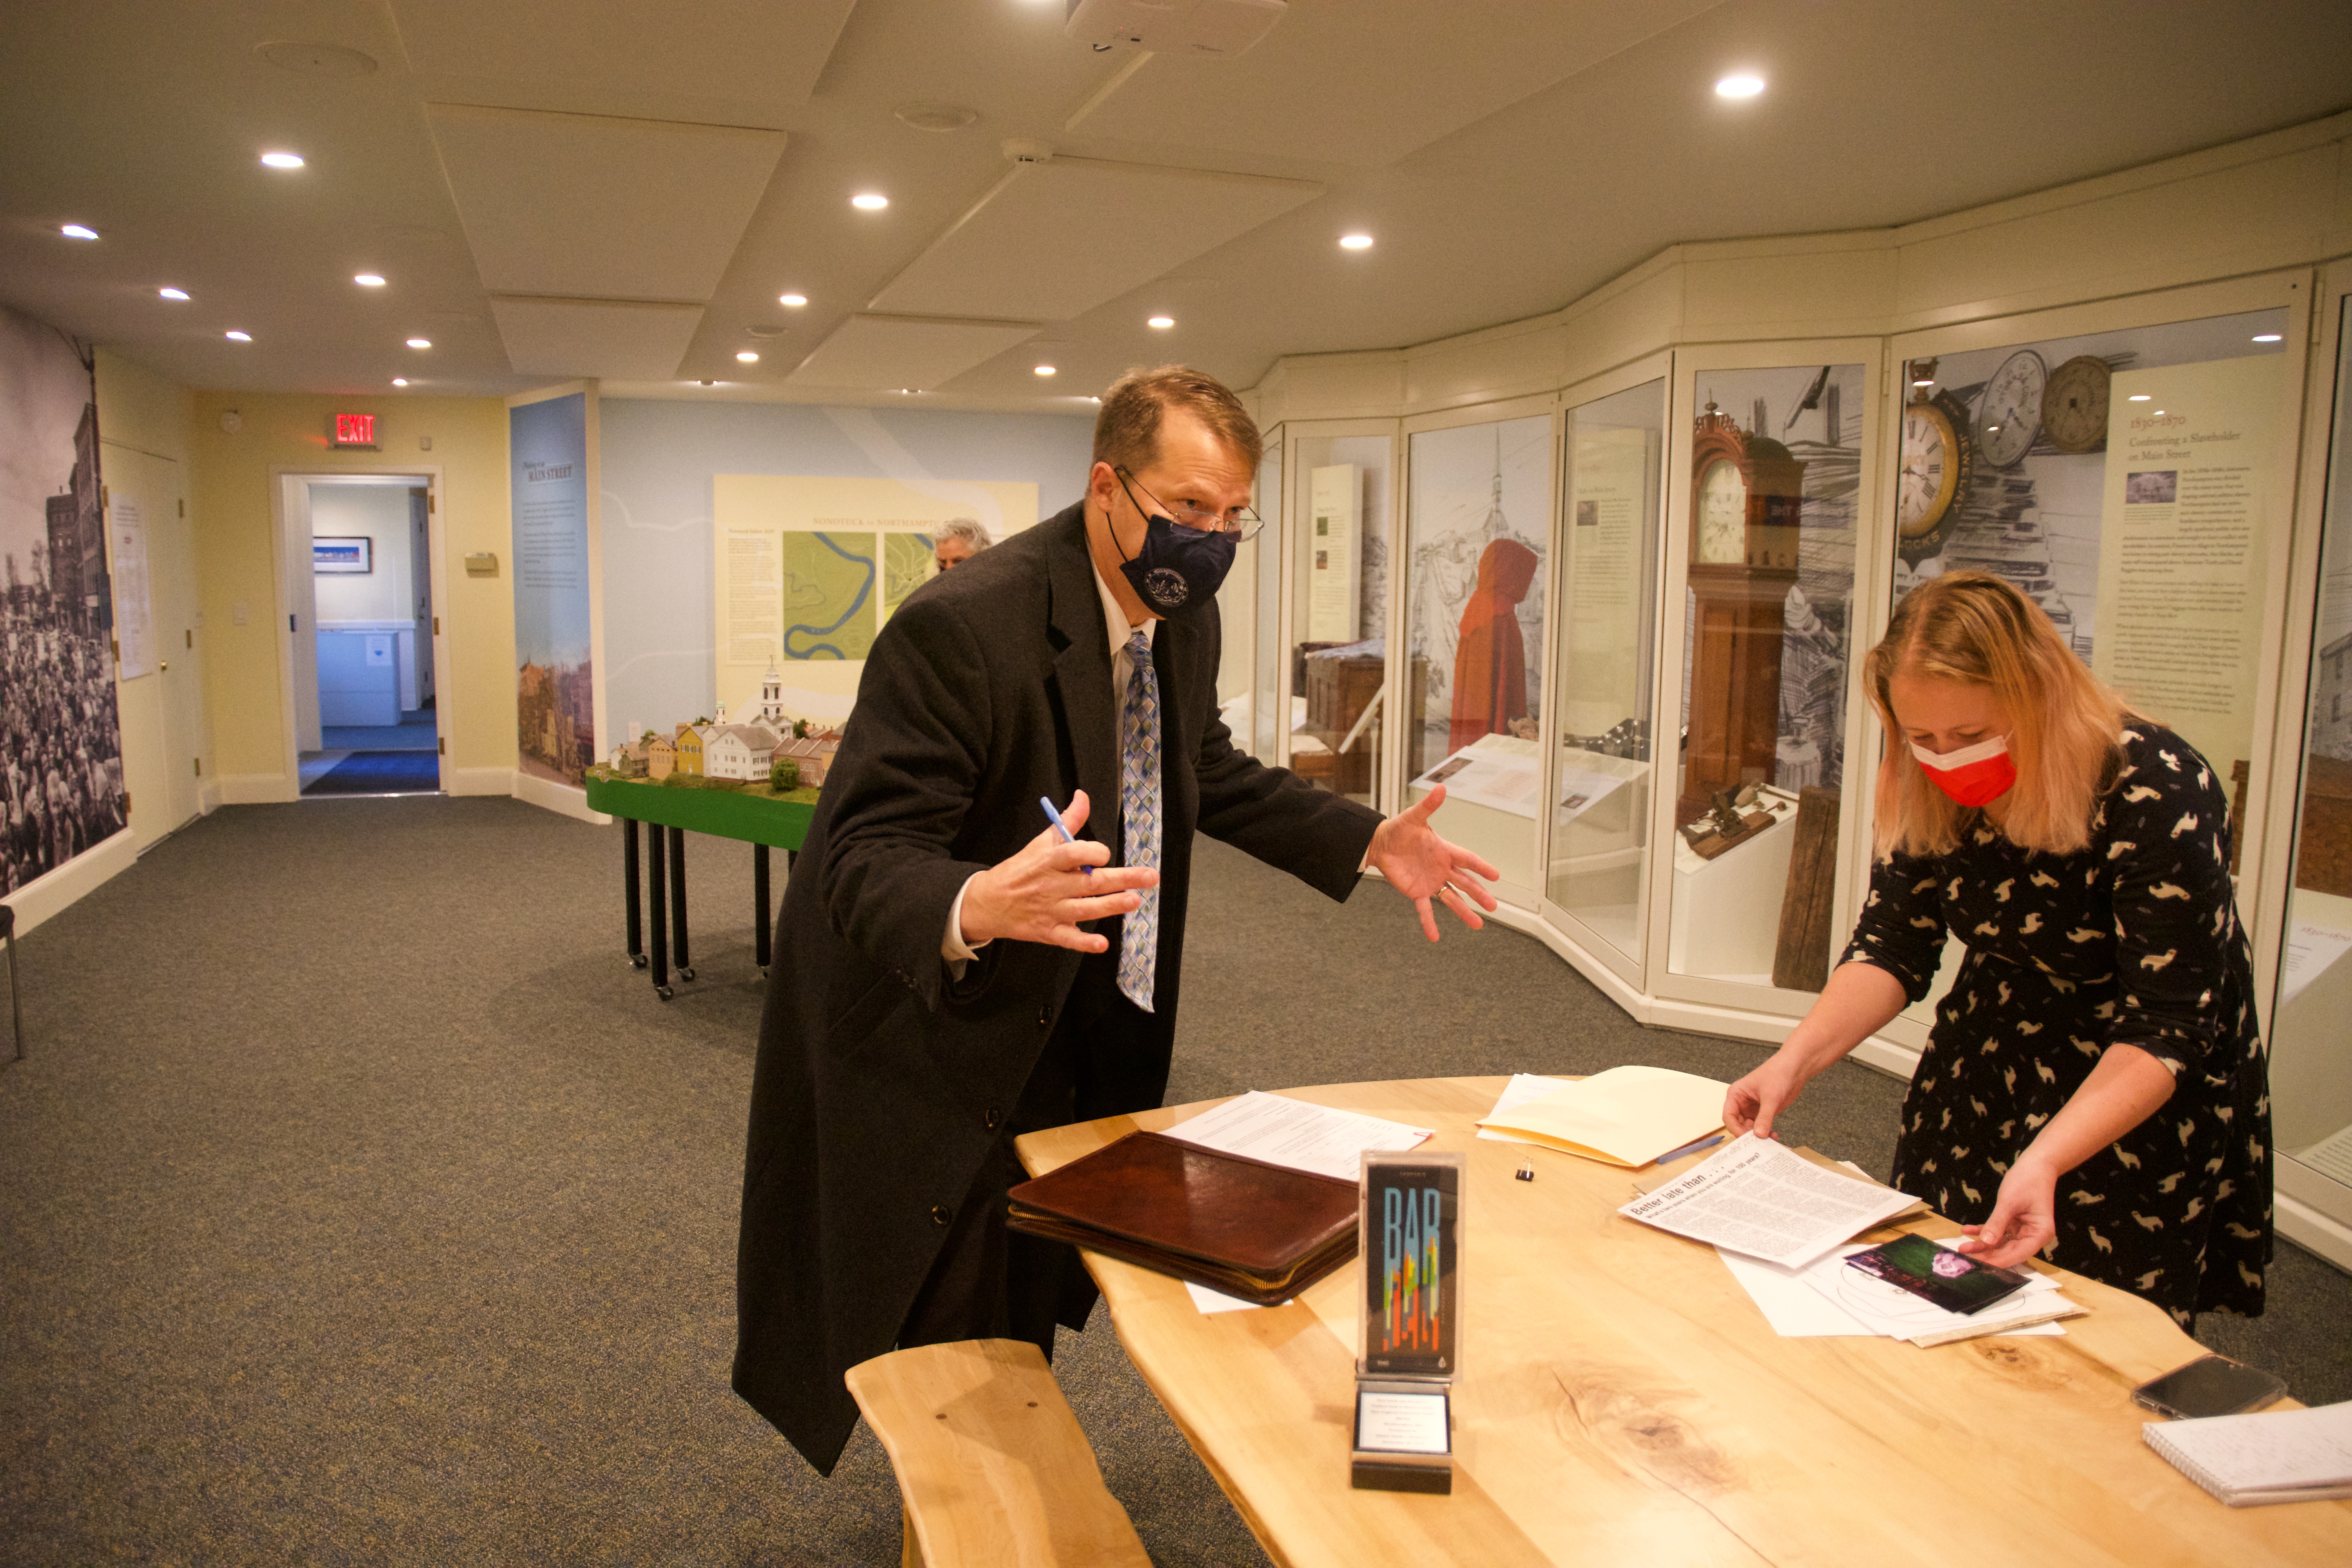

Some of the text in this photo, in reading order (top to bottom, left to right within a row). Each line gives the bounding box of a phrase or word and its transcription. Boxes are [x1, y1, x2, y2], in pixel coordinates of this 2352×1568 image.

[337, 414, 375, 443] EXIT
[2129, 435, 2180, 447] Confronting
[2190, 430, 2241, 443] Slaveholder
[2141, 450, 2164, 461] Main
[2166, 449, 2191, 459] Street
[529, 466, 572, 481] MAIN STREET
[813, 517, 864, 526] NONOTUCK
[877, 519, 937, 527] NORTHAMPT
[1673, 1199, 1686, 1207] years
[1685, 1192, 1698, 1200] when
[1713, 1173, 1731, 1185] waiting
[1735, 1161, 1746, 1170] 100
[1746, 1152, 1760, 1165] years?
[1631, 1198, 1663, 1215] Better
[1661, 1188, 1684, 1200] late
[1682, 1174, 1707, 1189] than
[1383, 1187, 1441, 1352] BAR
